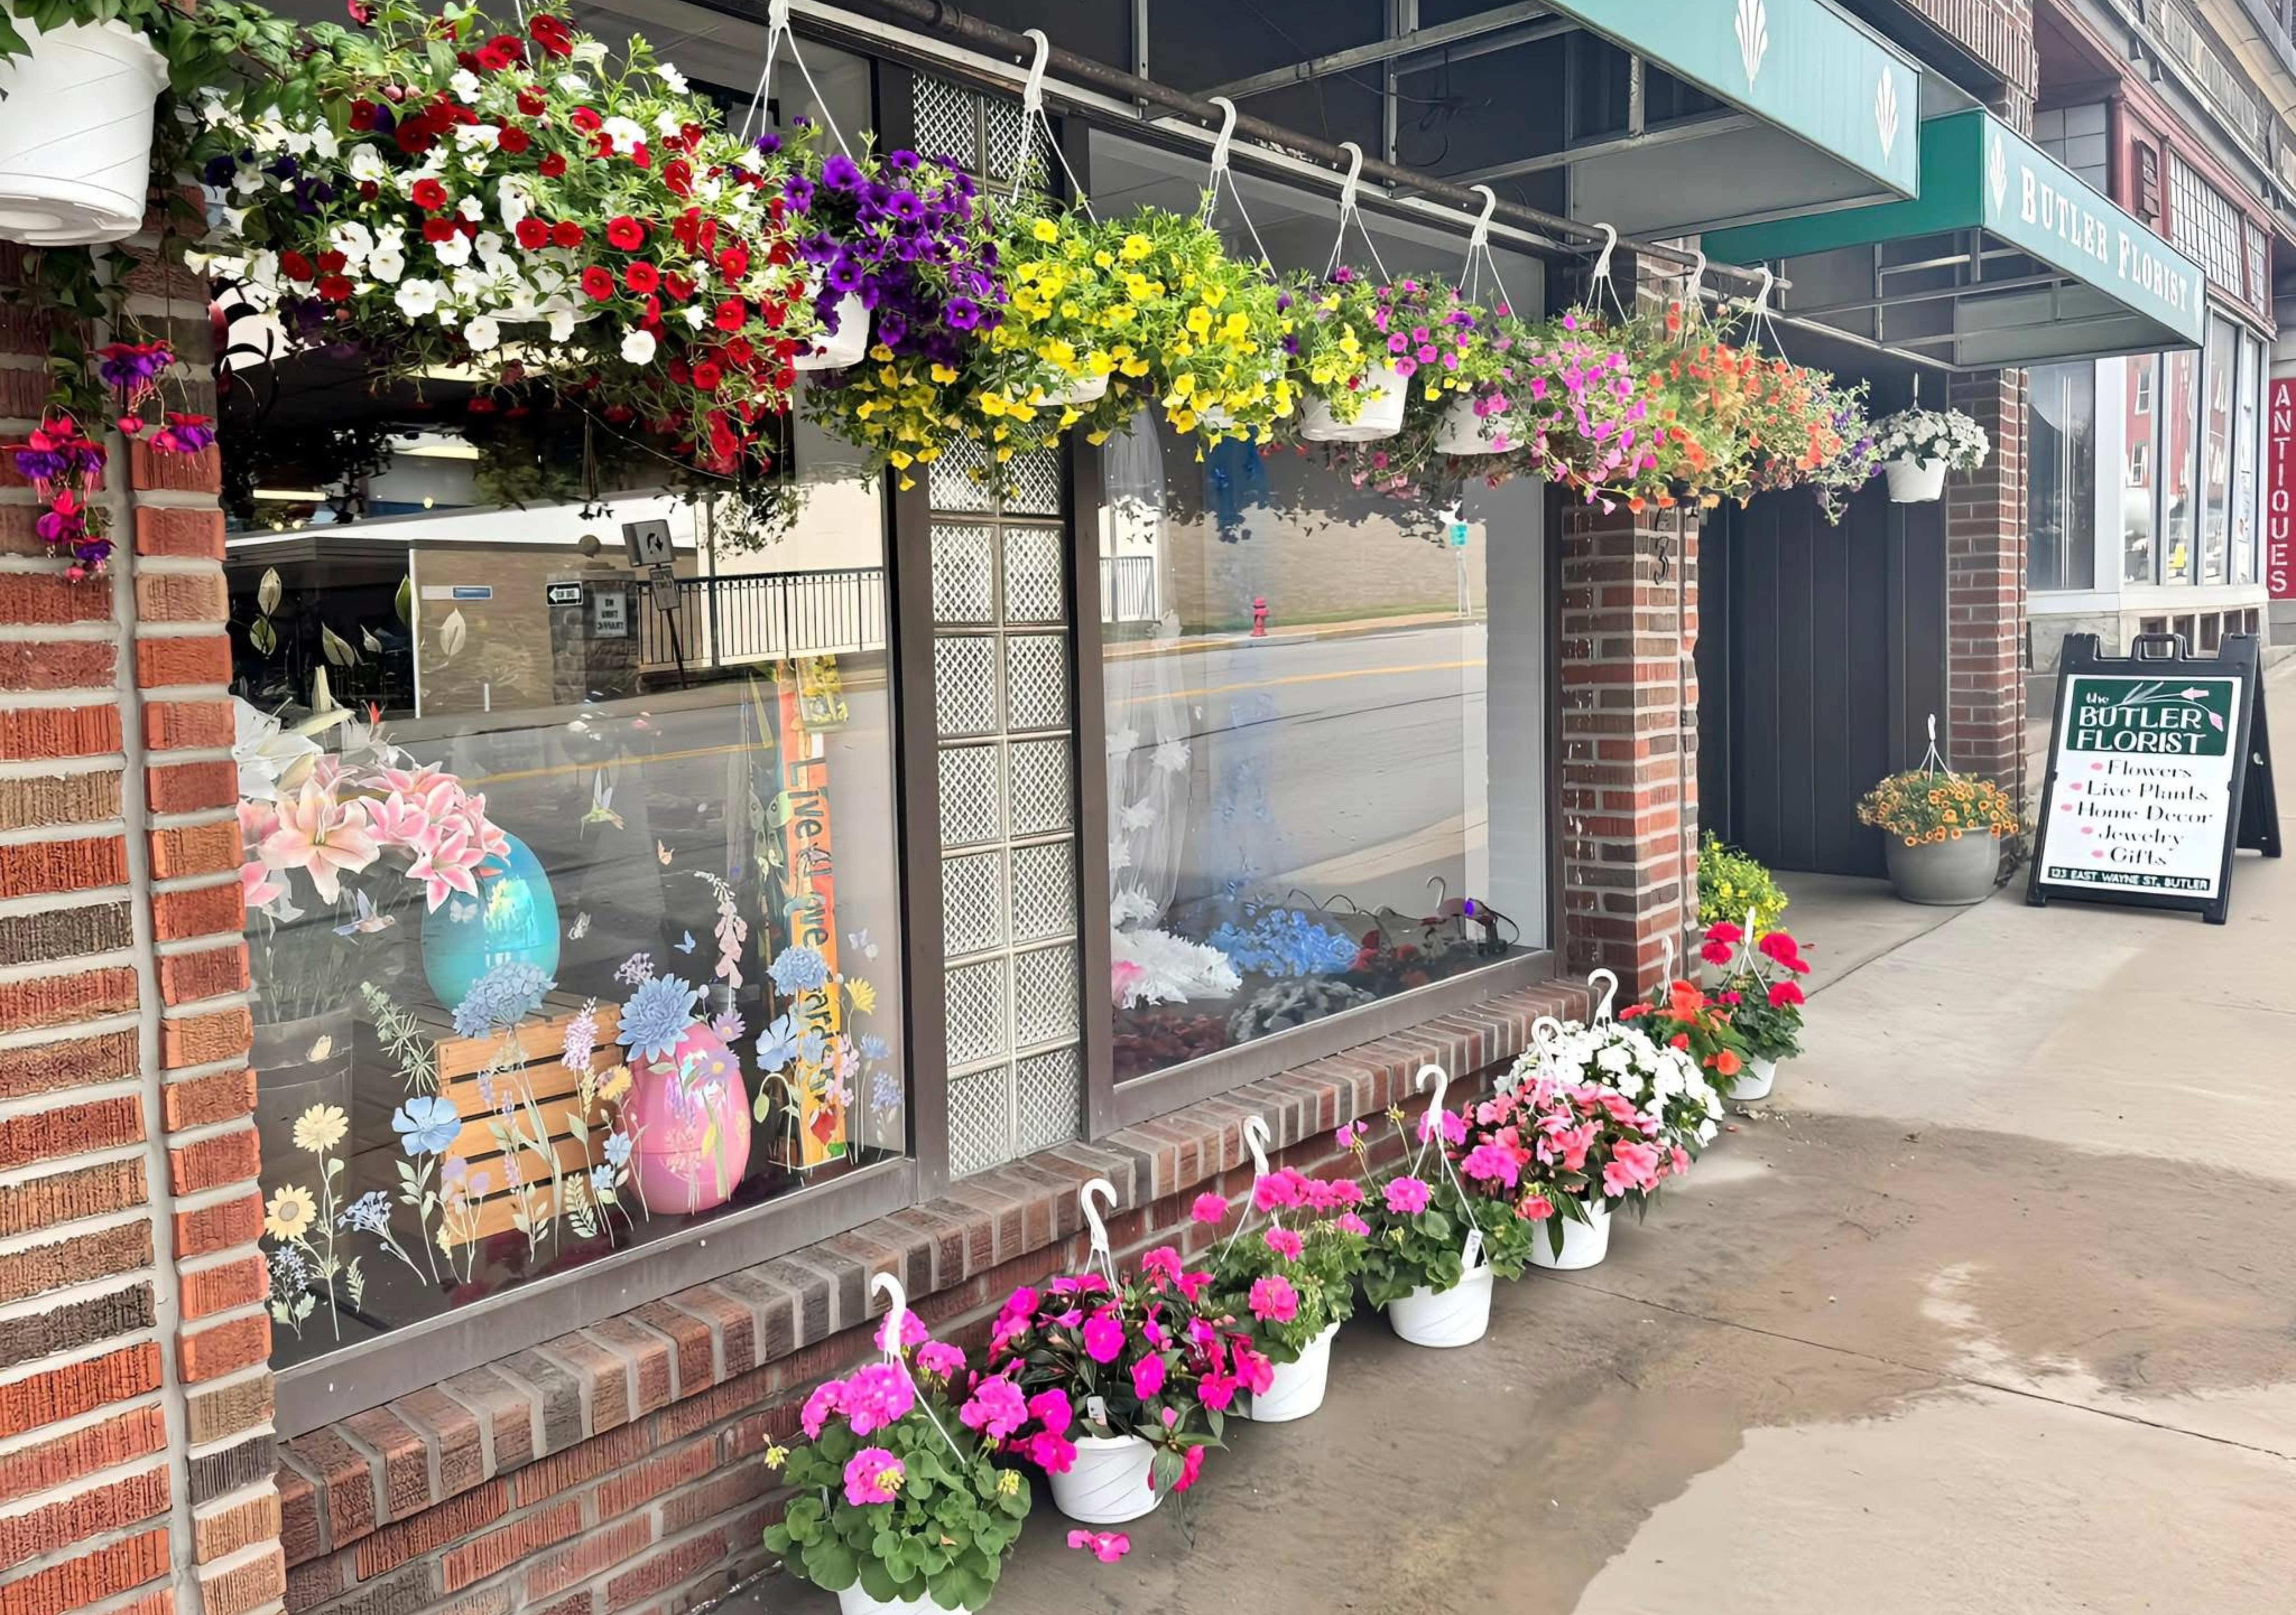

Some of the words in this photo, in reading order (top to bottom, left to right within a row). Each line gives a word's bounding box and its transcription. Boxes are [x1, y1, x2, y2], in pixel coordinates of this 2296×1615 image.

[2020, 165, 2108, 264] BUTLER
[2117, 231, 2188, 313] FLORIST
[2270, 383, 2291, 592] ANTIQUES
[2086, 692, 2110, 704] the
[2079, 706, 2202, 729] BUTLER
[2077, 729, 2207, 754] FLORIST
[2108, 760, 2192, 777] Flowers
[788, 757, 828, 841] Live
[2087, 780, 2131, 796] Live
[2140, 783, 2208, 800] Plants
[2078, 801, 2138, 818] Home
[2147, 805, 2213, 823] Decor
[2099, 824, 2184, 851] Jewelry
[2110, 846, 2167, 865] Gifts
[2070, 870, 2098, 883] EAST
[2101, 872, 2139, 886] WAYNE
[2164, 878, 2208, 890] BUTLER
